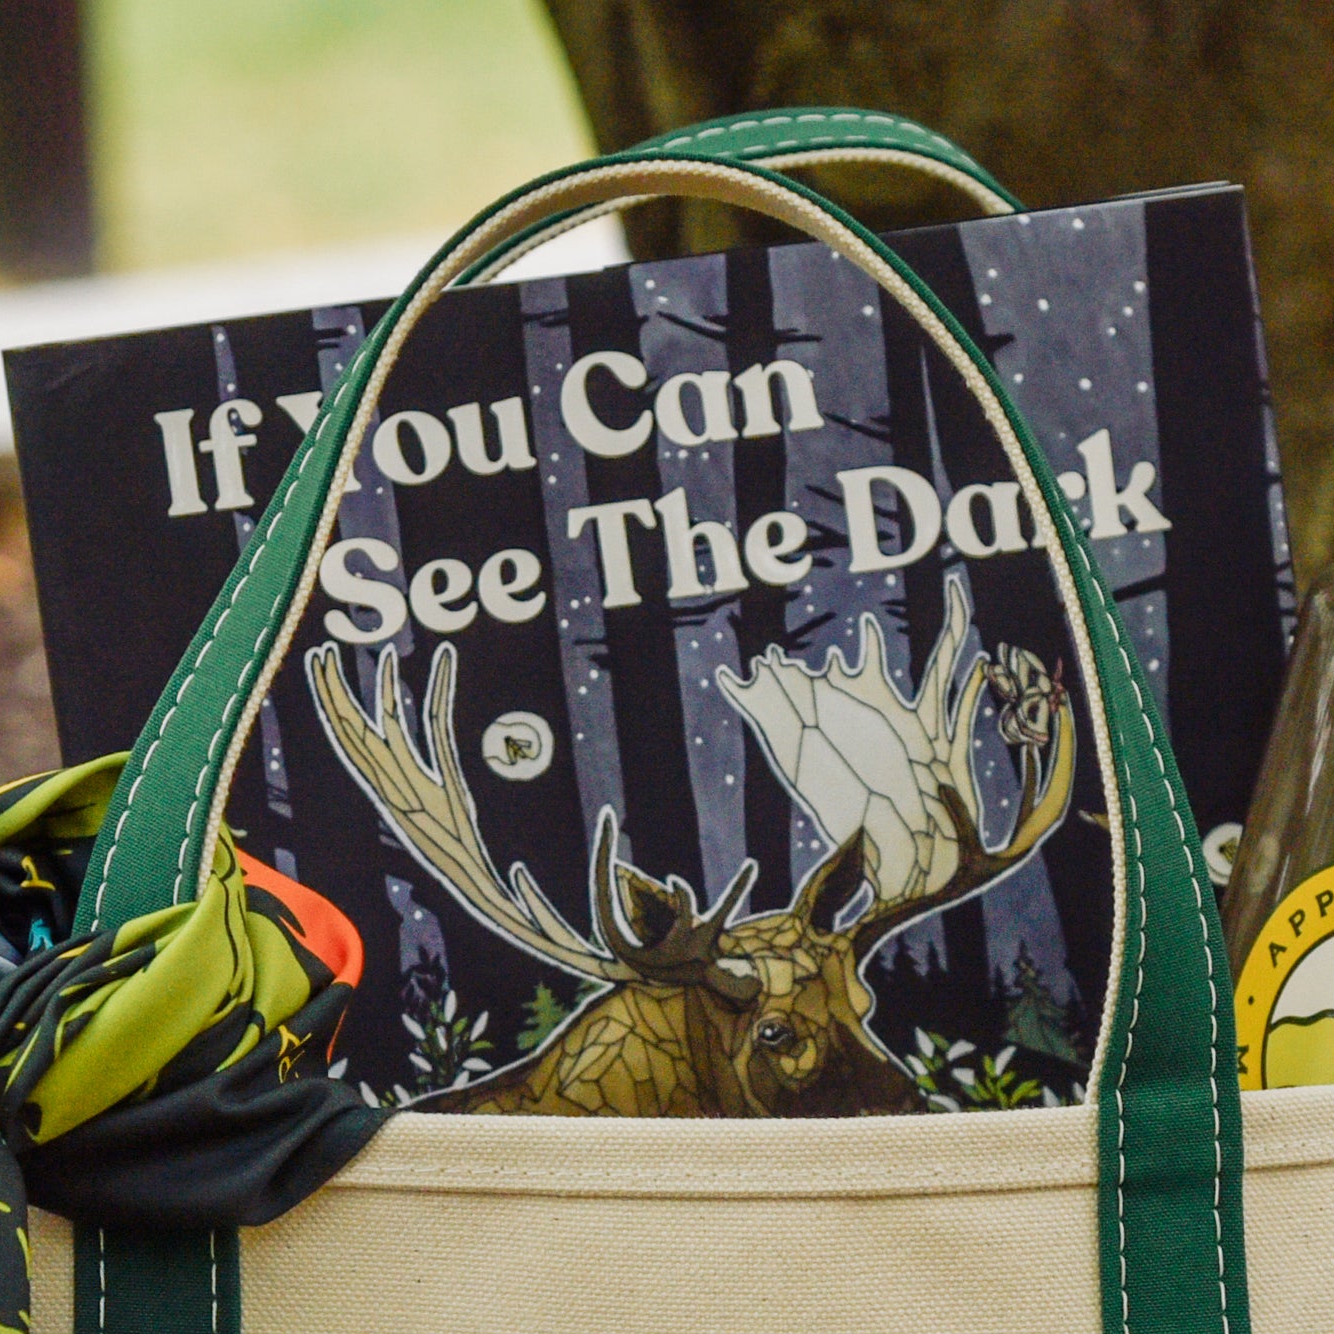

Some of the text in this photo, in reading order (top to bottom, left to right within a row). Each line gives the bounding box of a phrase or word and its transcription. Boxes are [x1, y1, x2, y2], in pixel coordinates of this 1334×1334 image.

[154, 398, 263, 518] If
[560, 350, 824, 458] Can
[318, 537, 547, 645] See
[568, 486, 813, 609] The
